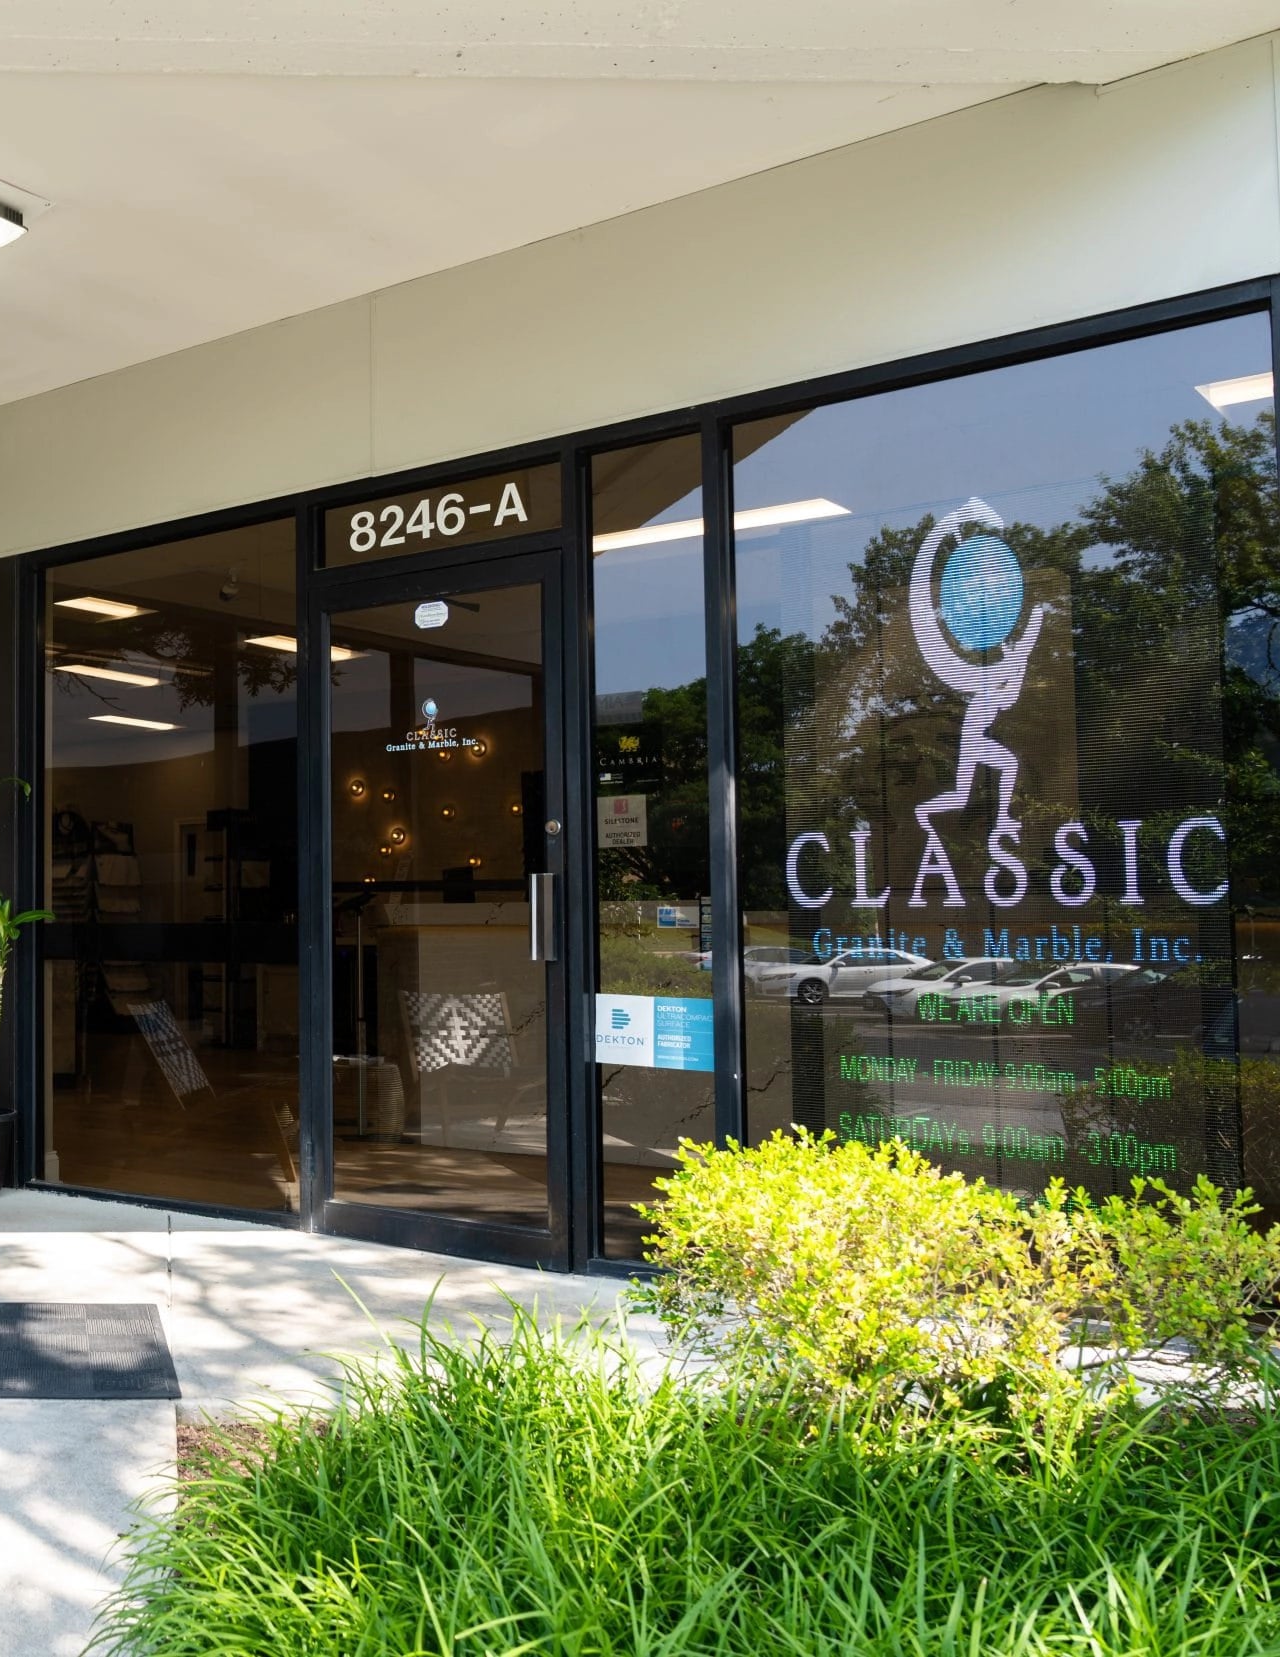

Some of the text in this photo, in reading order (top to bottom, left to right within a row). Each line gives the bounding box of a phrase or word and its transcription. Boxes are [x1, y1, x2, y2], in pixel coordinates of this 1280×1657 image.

[349, 482, 528, 552] 8246-A
[386, 737, 479, 752] Granite & Marble, Inc.
[406, 728, 457, 741] CLASSIC
[605, 831, 641, 839] AUTHORIZED
[786, 817, 1230, 908] CLASSIC
[812, 926, 1203, 963] Granite & Marble, Inc.
[657, 1005, 687, 1014] DEKTON
[917, 992, 1074, 1025] WE ARE OPEN
[596, 1034, 645, 1046] DEKTON
[839, 1055, 918, 1083] MONDAY
[1005, 1063, 1076, 1093] 9:00am
[1094, 1067, 1172, 1106] 5:00pm
[981, 1123, 1065, 1162] 9:00am
